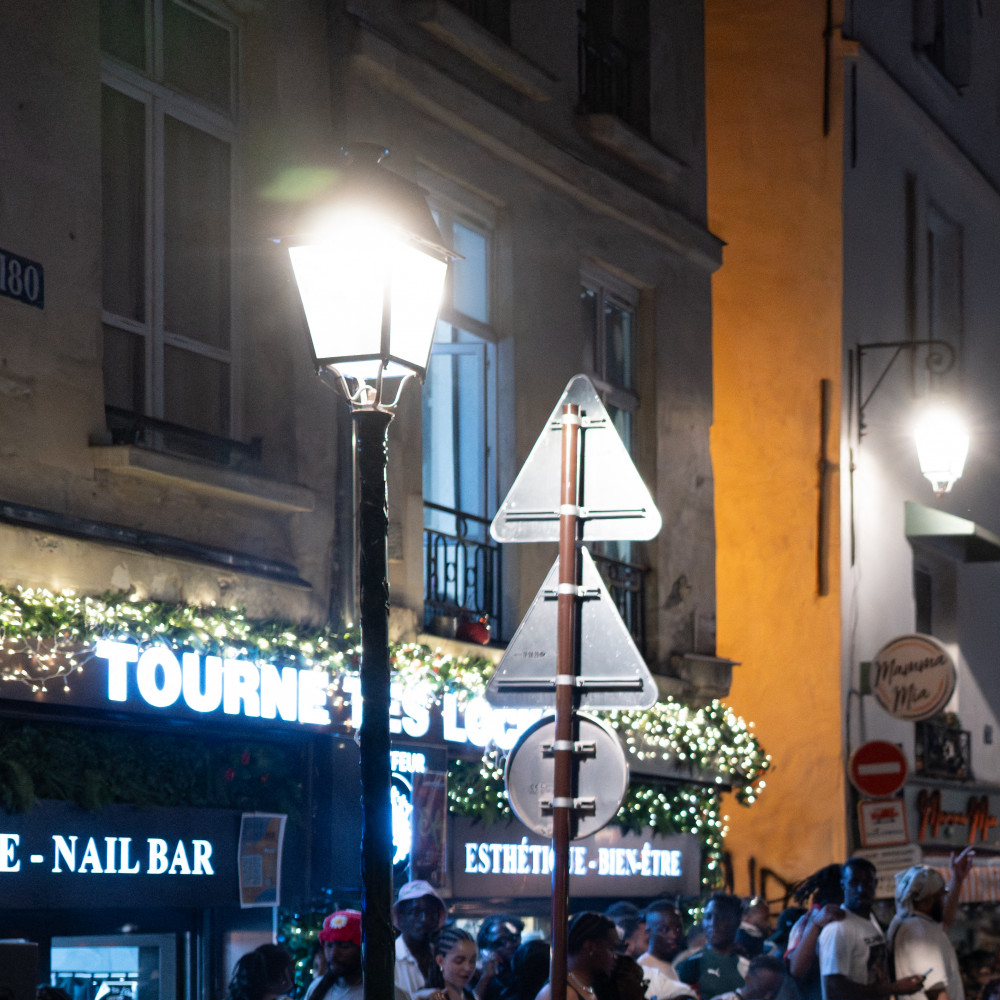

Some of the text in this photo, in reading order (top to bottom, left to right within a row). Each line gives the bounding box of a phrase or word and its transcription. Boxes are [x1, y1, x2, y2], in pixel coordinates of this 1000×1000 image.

[95, 639, 331, 725] TOURNE
[52, 835, 140, 873] NAIL
[147, 838, 215, 875] BAR
[465, 836, 587, 876] ESTHÉTIE
